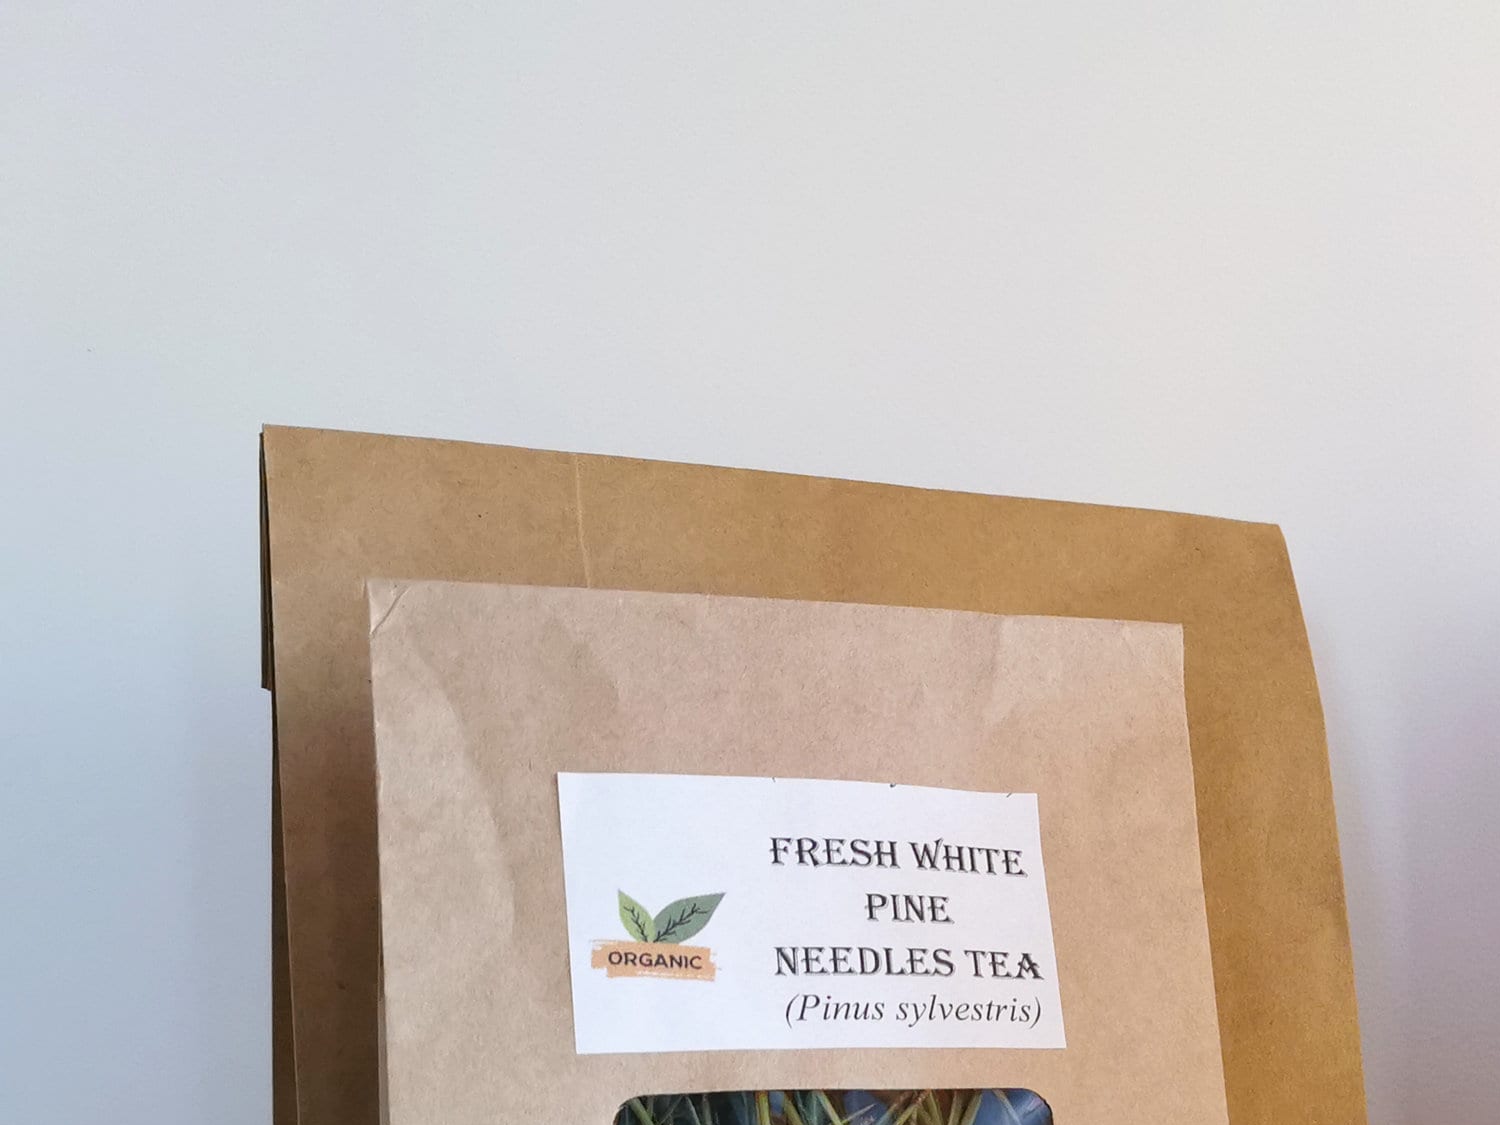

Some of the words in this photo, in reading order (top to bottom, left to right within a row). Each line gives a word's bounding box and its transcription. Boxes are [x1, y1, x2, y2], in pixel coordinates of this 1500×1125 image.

[769, 836, 901, 870] FRESH
[909, 838, 1028, 878] WHITE
[864, 893, 954, 925] PINE
[607, 950, 703, 971] ORGANIC
[774, 946, 957, 979] NEEDLES
[964, 949, 1044, 981] TEA
[785, 993, 885, 1028] (Pinus
[895, 996, 1042, 1029] sylvestris)
